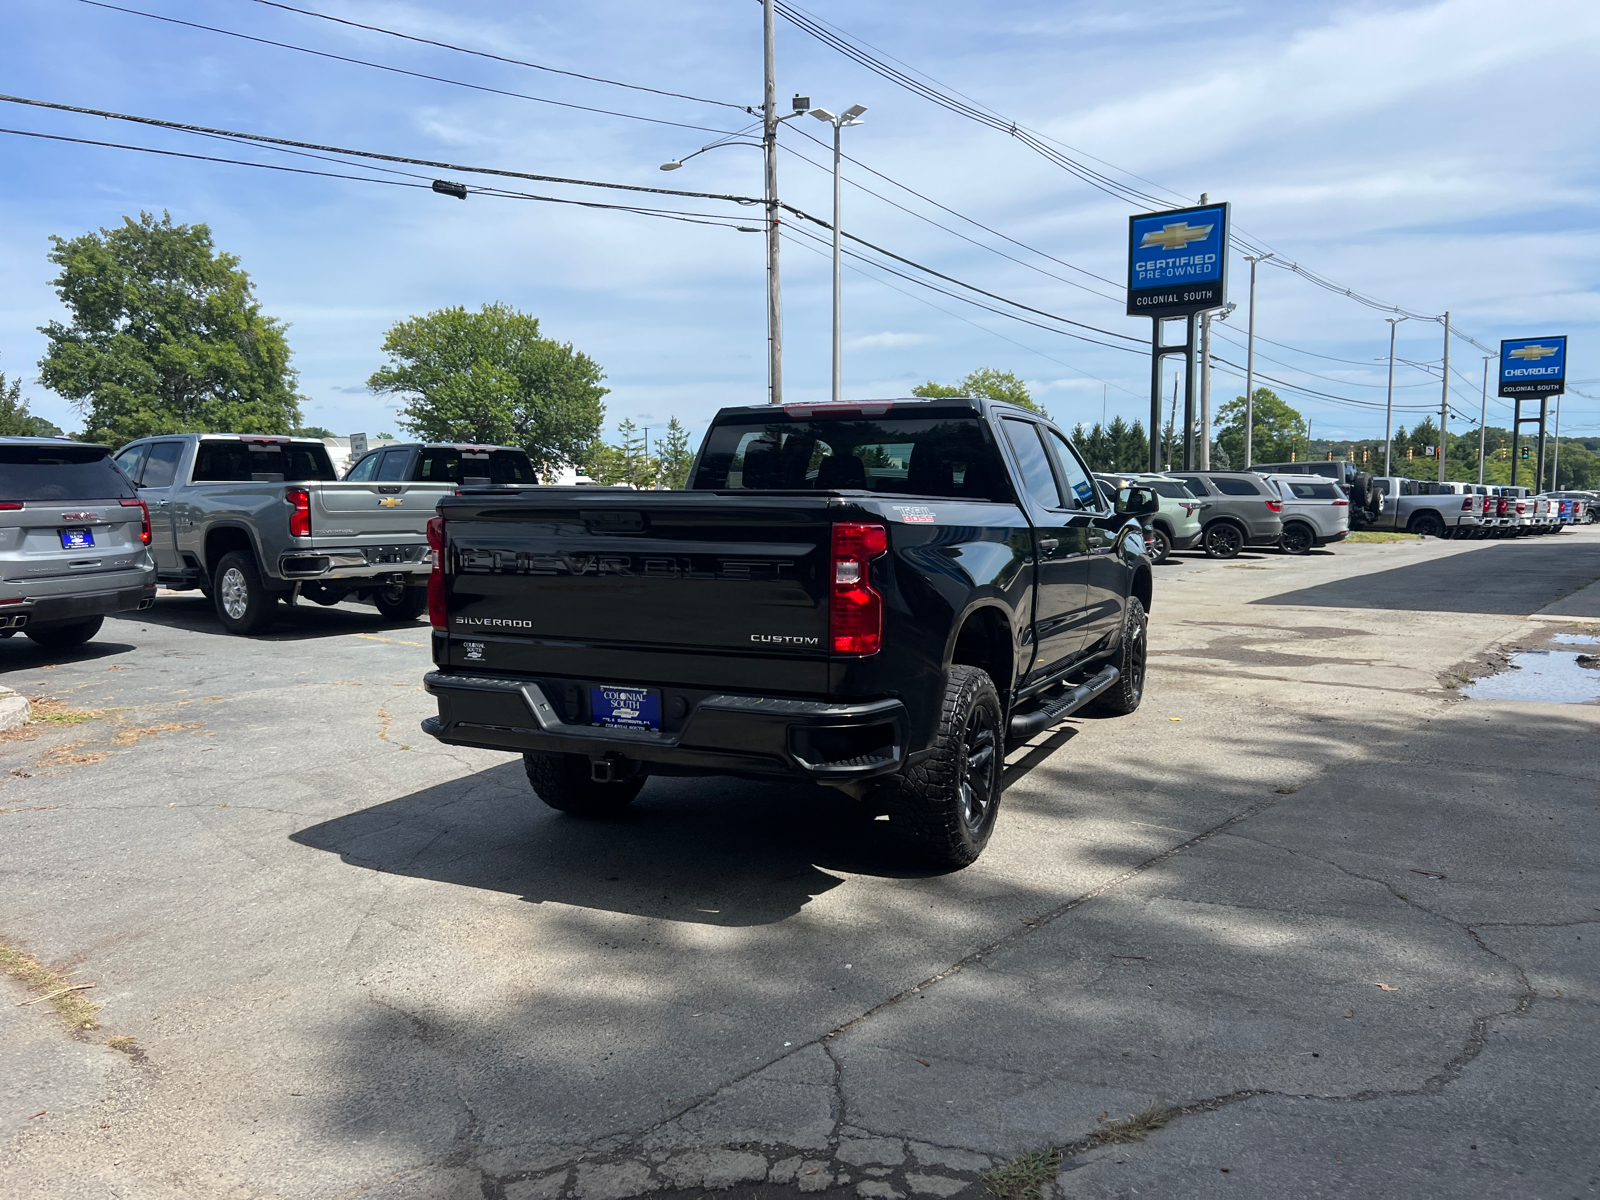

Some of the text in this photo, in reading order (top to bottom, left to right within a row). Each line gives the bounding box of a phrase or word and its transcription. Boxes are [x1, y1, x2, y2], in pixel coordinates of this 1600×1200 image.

[1135, 253, 1216, 271] CERTIFIED
[1139, 264, 1211, 279] PRE-OWNED
[1136, 290, 1213, 306] COLONIAL SOUTH
[1505, 366, 1560, 377] CHEVROLET
[1503, 385, 1535, 393] COLONIAL
[62, 511, 99, 521] GMC
[902, 515, 935, 523] BOSS
[459, 548, 795, 582] CHEVROLET
[455, 616, 532, 628] SILVERADO
[750, 634, 819, 645] CUSTOM
[603, 691, 646, 702] COLONIAL
[610, 700, 640, 709] SOUTH
